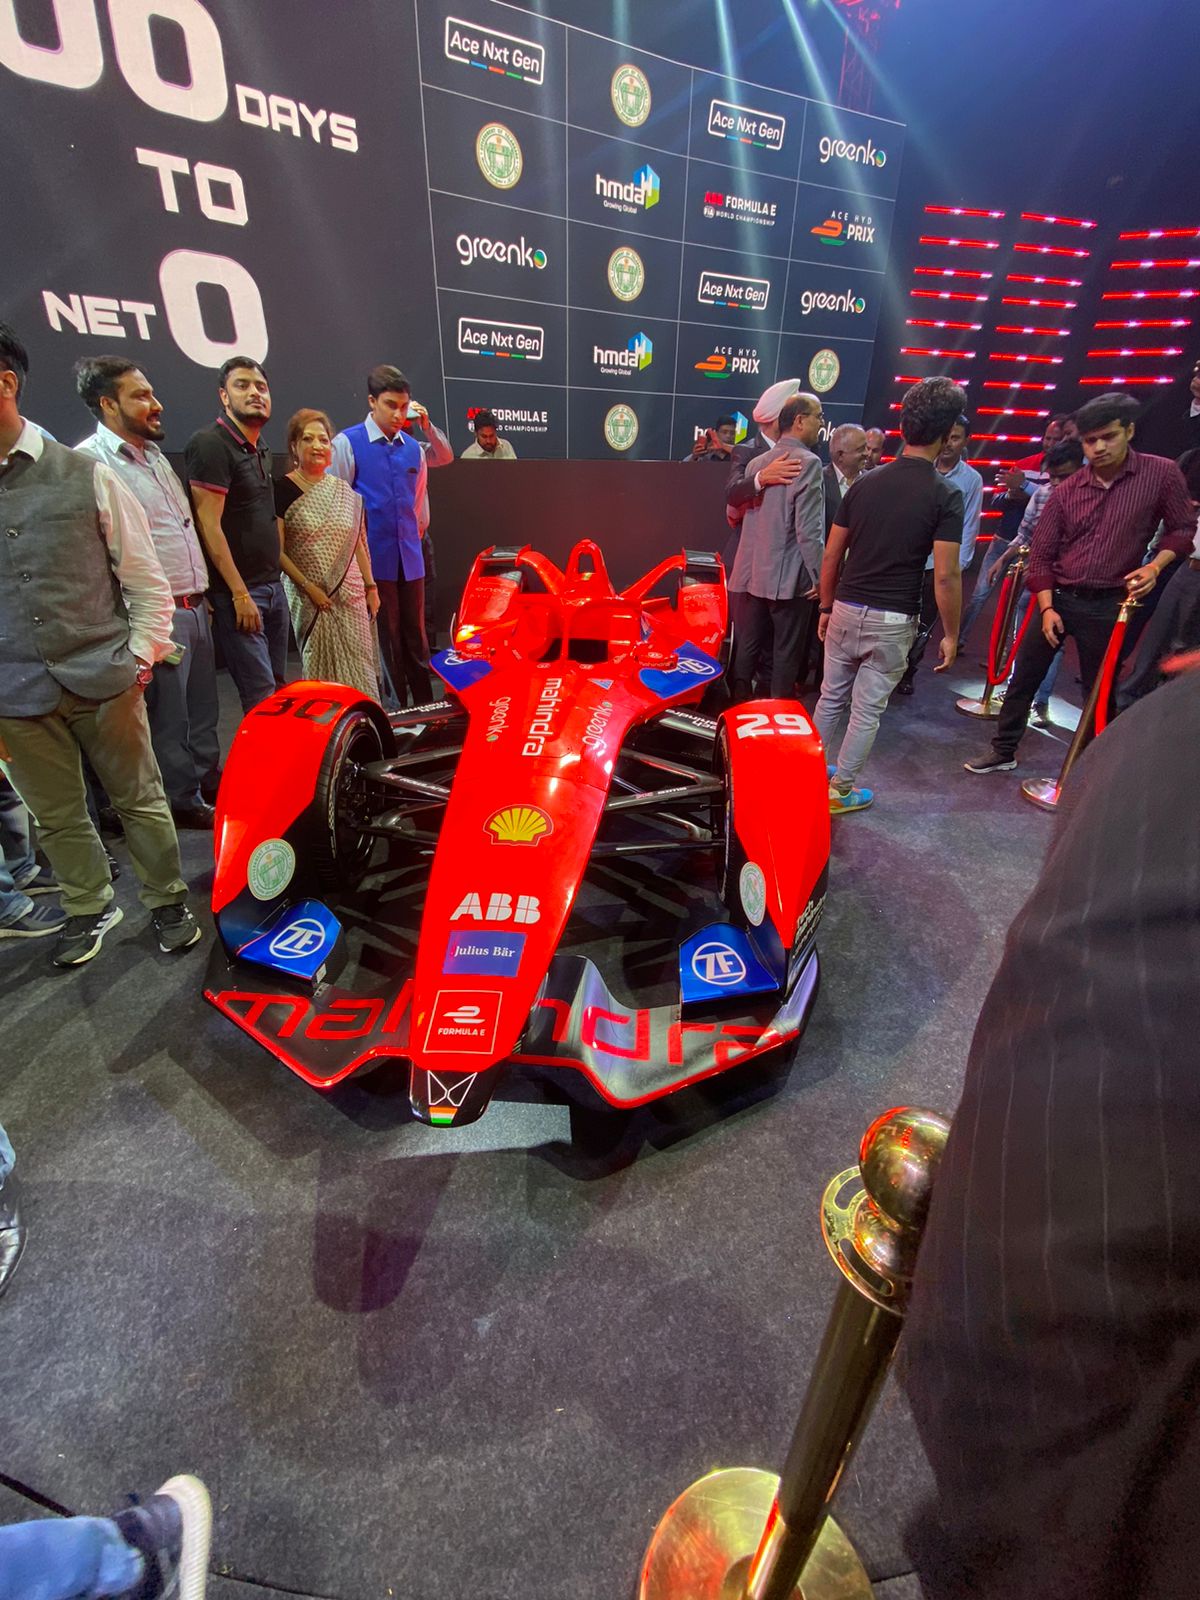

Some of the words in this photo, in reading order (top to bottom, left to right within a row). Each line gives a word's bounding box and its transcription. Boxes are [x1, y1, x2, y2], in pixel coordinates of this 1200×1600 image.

[450, 30, 480, 54] Ace
[483, 40, 509, 65] Nxt
[512, 49, 540, 73] Gen
[235, 83, 359, 153] DAYS
[712, 110, 734, 129] Ace
[737, 117, 756, 135] Nxt
[758, 122, 780, 140] Gen
[819, 136, 887, 168] greenko
[136, 147, 249, 226] TO
[596, 172, 645, 205] hmda
[716, 210, 735, 220] WORLD
[725, 195, 768, 215] FORMULA
[770, 204, 777, 216] E
[831, 211, 849, 222] ACE
[854, 215, 873, 225] HYD
[456, 234, 547, 270] greenko
[702, 281, 723, 297] Ace
[724, 285, 743, 299] Nxt
[745, 287, 765, 302] Gen
[801, 289, 866, 315] greenko
[42, 290, 156, 340] NET
[159, 249, 269, 368] 0
[462, 328, 488, 345] Ace
[491, 332, 513, 348] Nxt
[516, 335, 540, 351] Gen
[594, 340, 638, 367] hmda
[714, 346, 732, 355] ACE
[739, 348, 757, 357] HYD
[491, 408, 540, 422] FORMULA
[541, 412, 548, 423] E
[504, 424, 548, 433] CHAMPIONSHIP
[254, 696, 345, 725] 30
[521, 678, 563, 757] mahindra
[736, 713, 813, 739] 29
[449, 892, 541, 924] ABB
[271, 922, 326, 957] ZF
[454, 945, 489, 957] Julius
[493, 946, 516, 957] Bär
[693, 948, 746, 982] ZF
[437, 1027, 478, 1036] FORMULA
[480, 1028, 486, 1036] E
